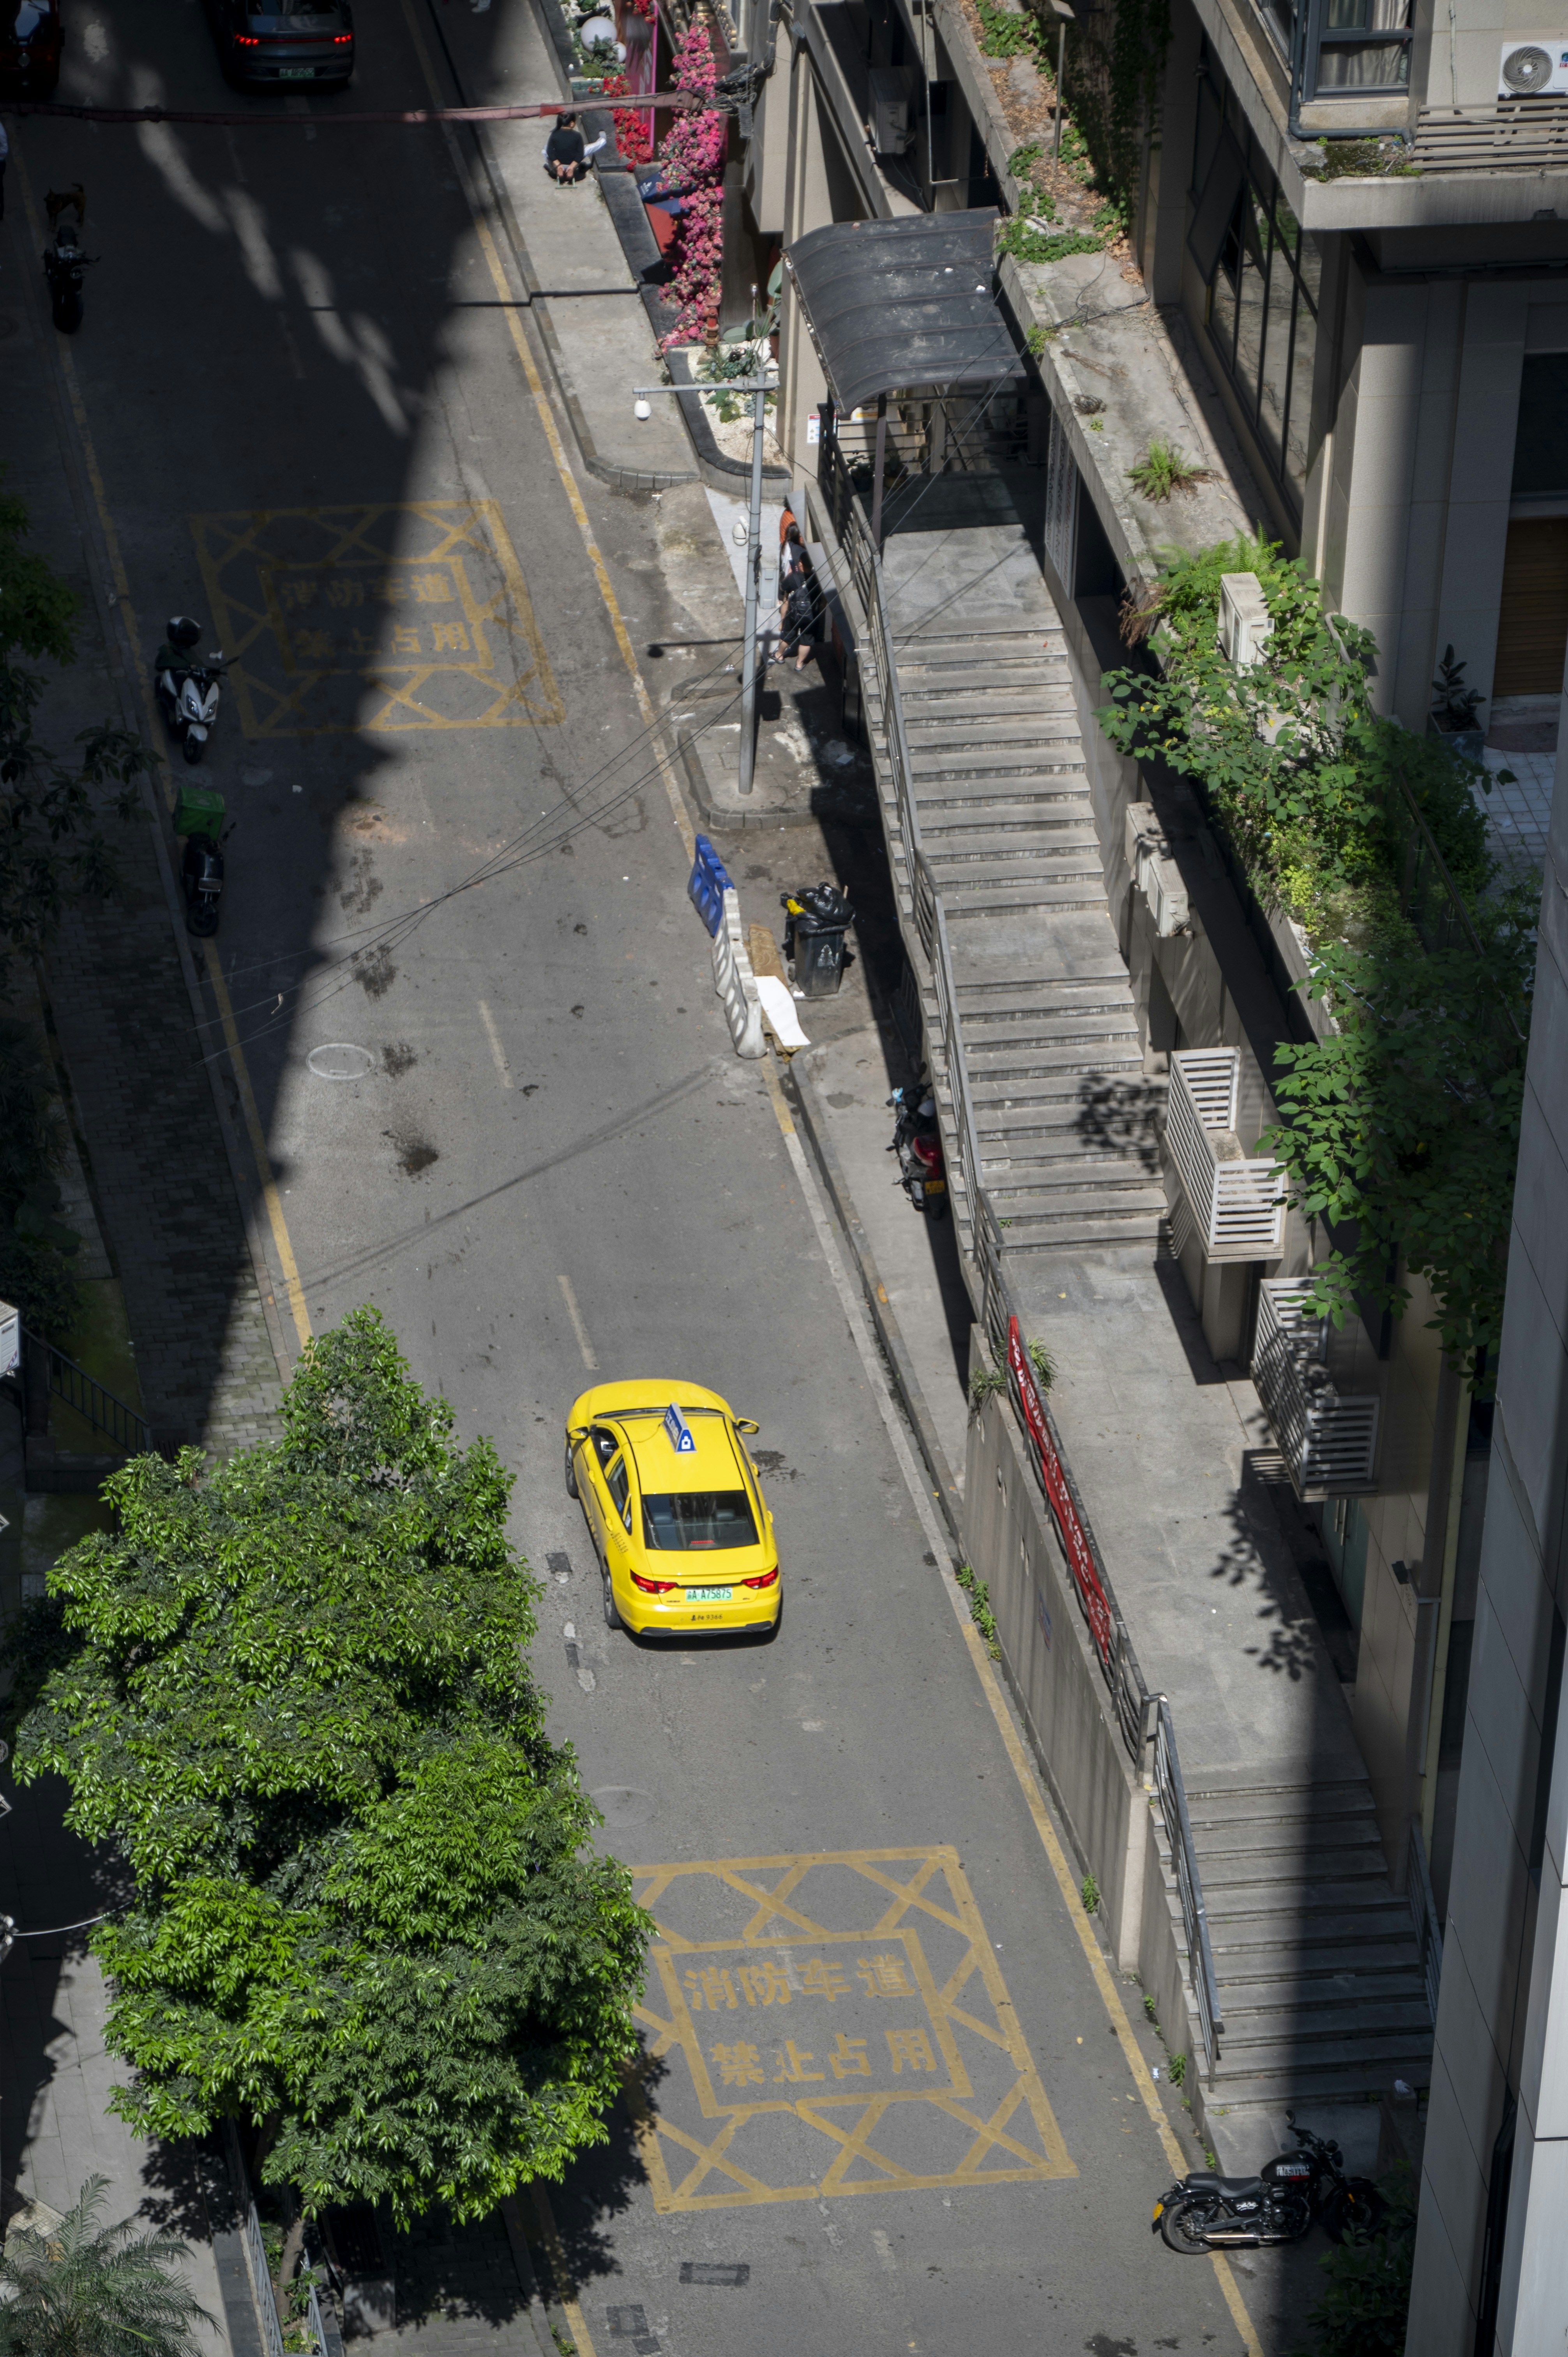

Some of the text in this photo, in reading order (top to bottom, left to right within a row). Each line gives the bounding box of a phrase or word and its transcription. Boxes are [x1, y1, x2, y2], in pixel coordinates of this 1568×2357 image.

[281, 573, 455, 608] 消防车道
[701, 1588, 731, 1599] A75875
[684, 1955, 916, 2010] 消防车道
[710, 2030, 936, 2087] 禁止占用
